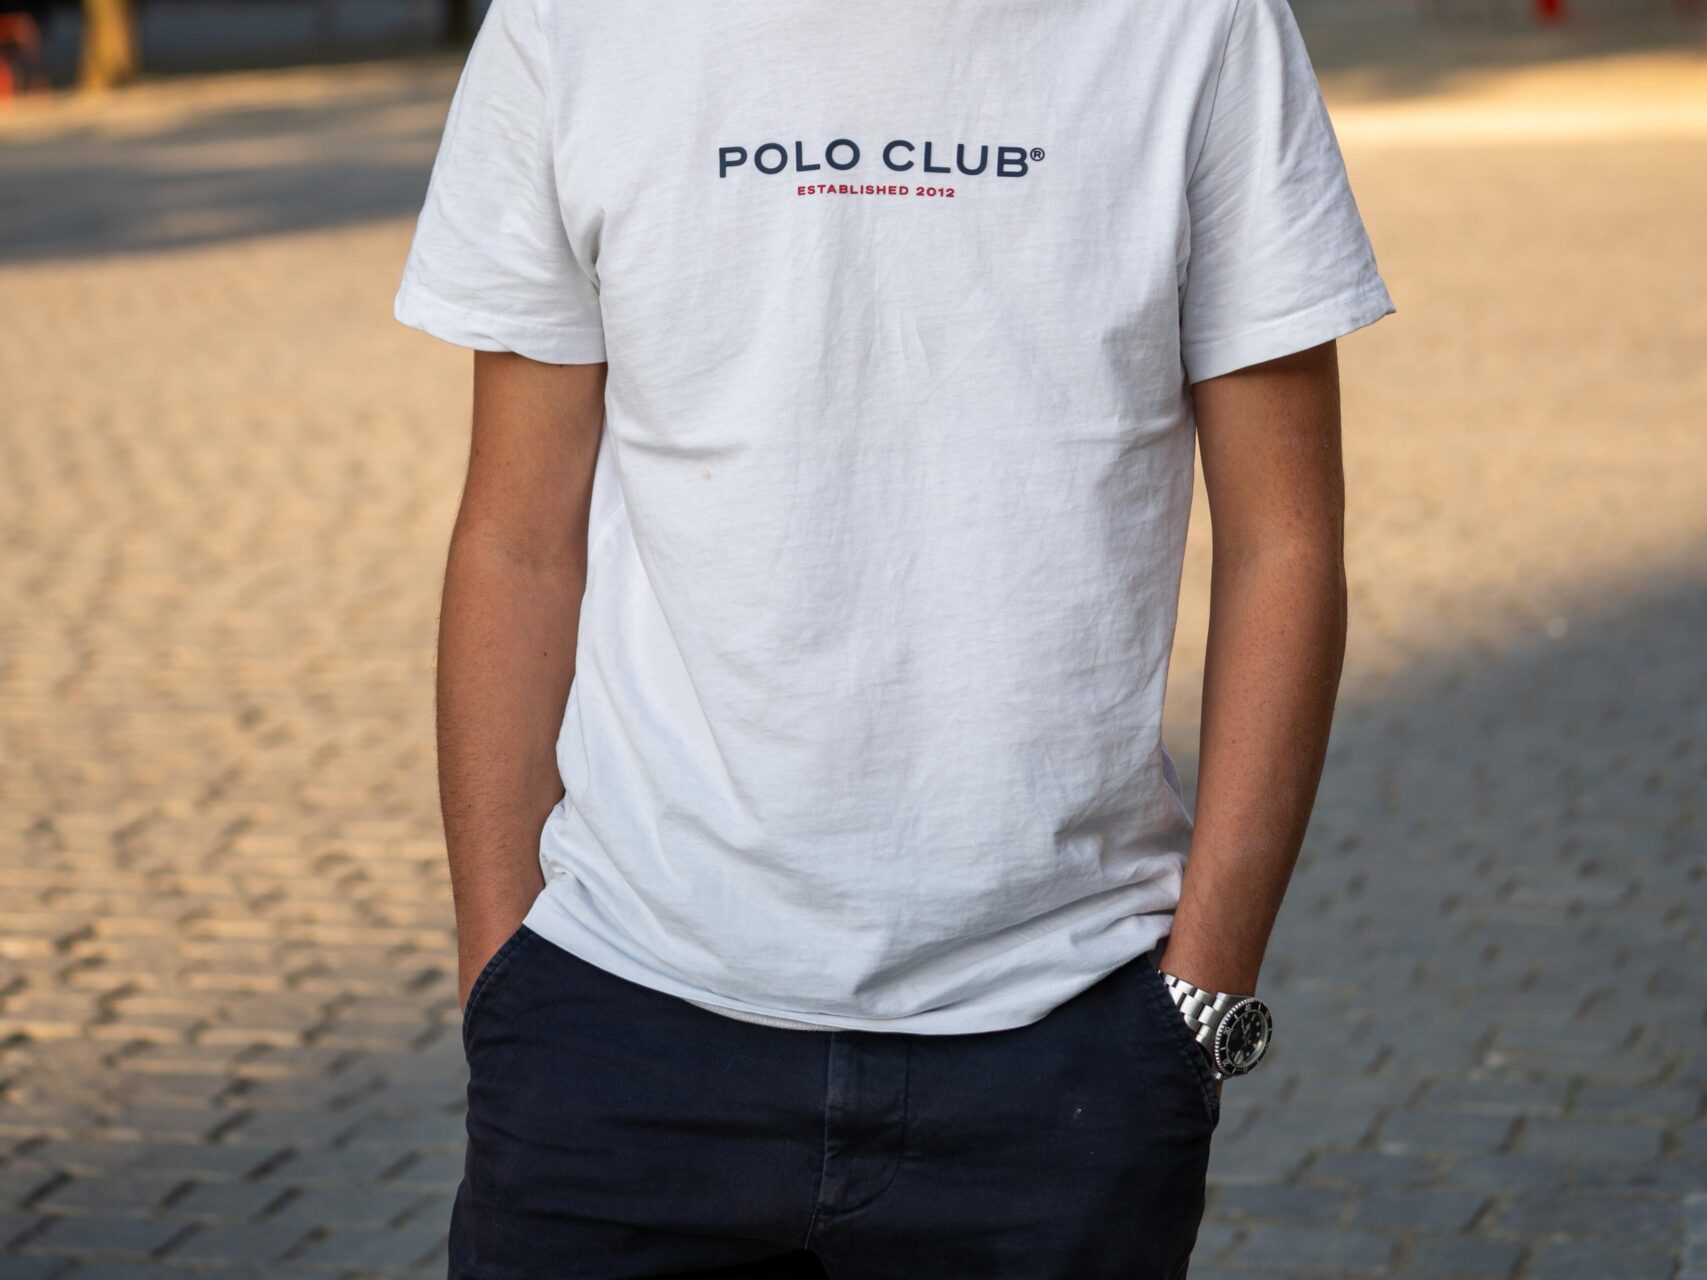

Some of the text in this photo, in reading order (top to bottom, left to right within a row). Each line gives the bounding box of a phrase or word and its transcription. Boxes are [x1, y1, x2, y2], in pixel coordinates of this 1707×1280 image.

[718, 138, 861, 179] POLO
[797, 184, 955, 198] ESTABLISHED 2012
